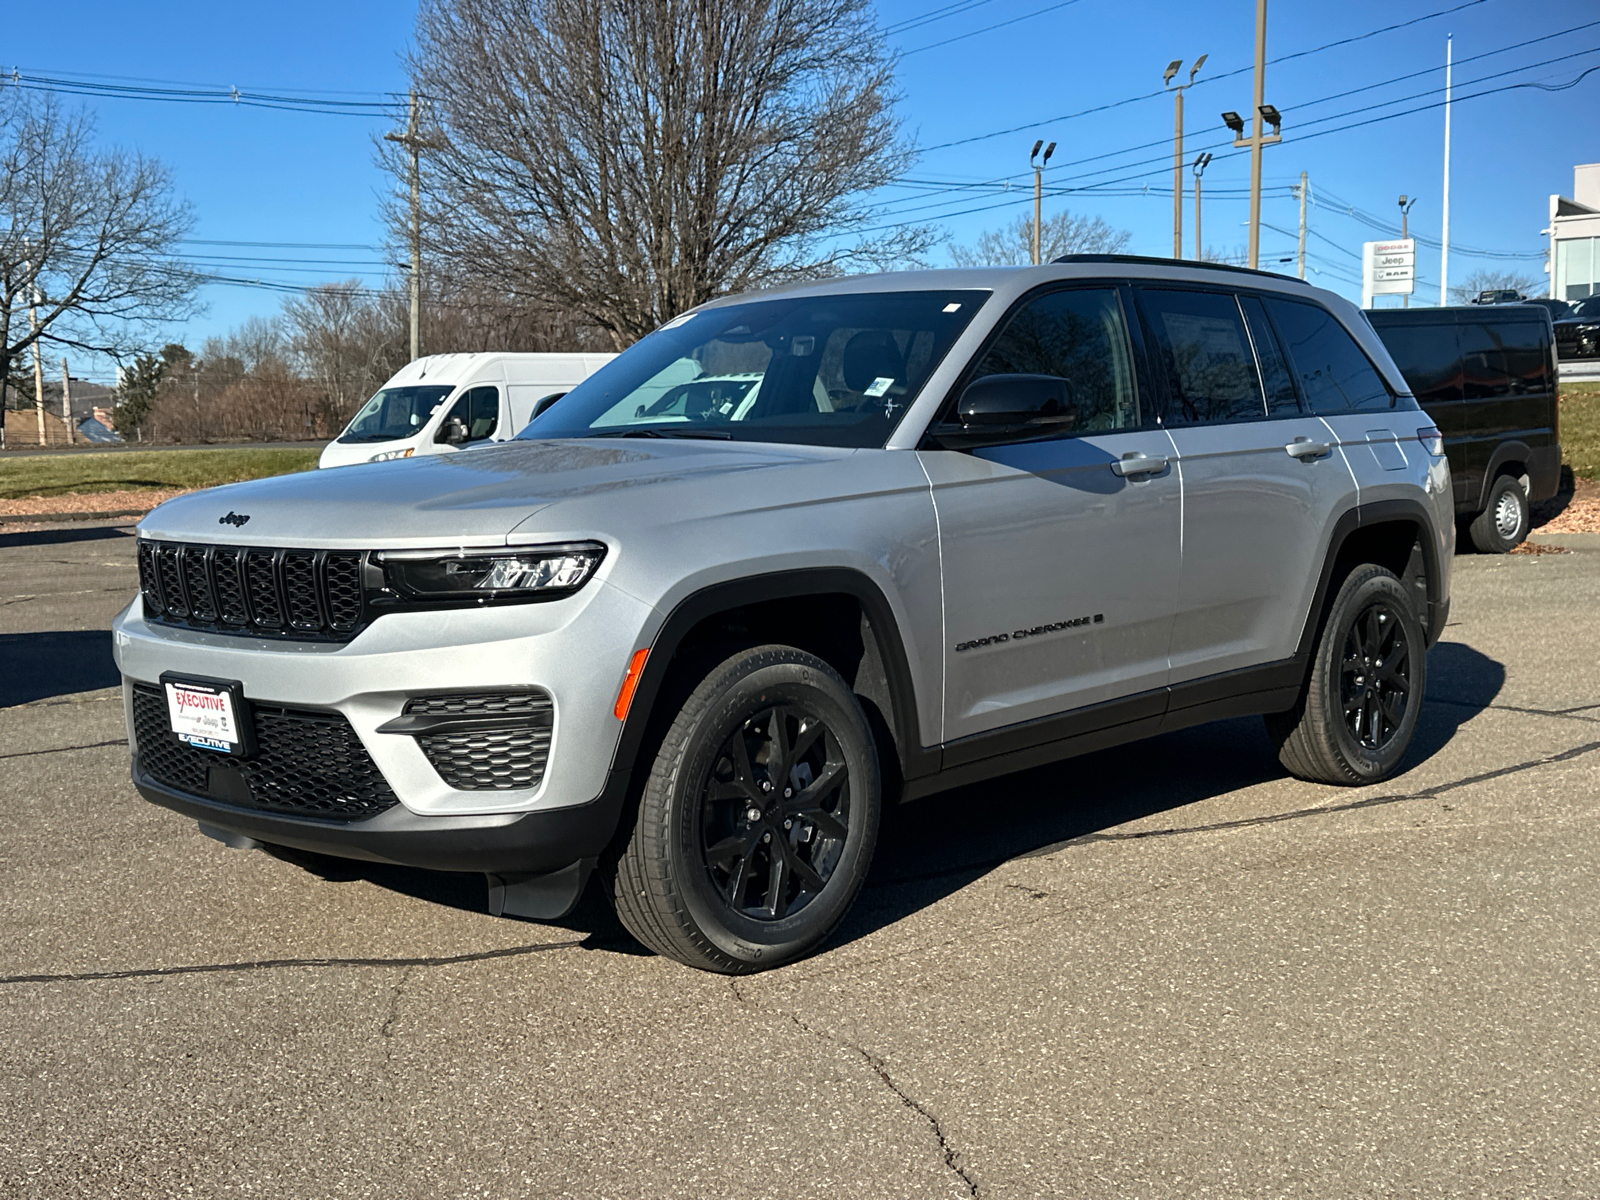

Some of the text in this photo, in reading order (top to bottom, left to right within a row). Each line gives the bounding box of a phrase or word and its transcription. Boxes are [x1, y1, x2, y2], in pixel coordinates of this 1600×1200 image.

[1377, 244, 1409, 252] DODGE
[1381, 256, 1405, 265] Jeep
[218, 510, 251, 528] Jeep
[955, 616, 1091, 652] GRAND CHEROKEE
[175, 689, 226, 713] EXECUTIVE
[178, 733, 231, 750] EXECUTIVE
